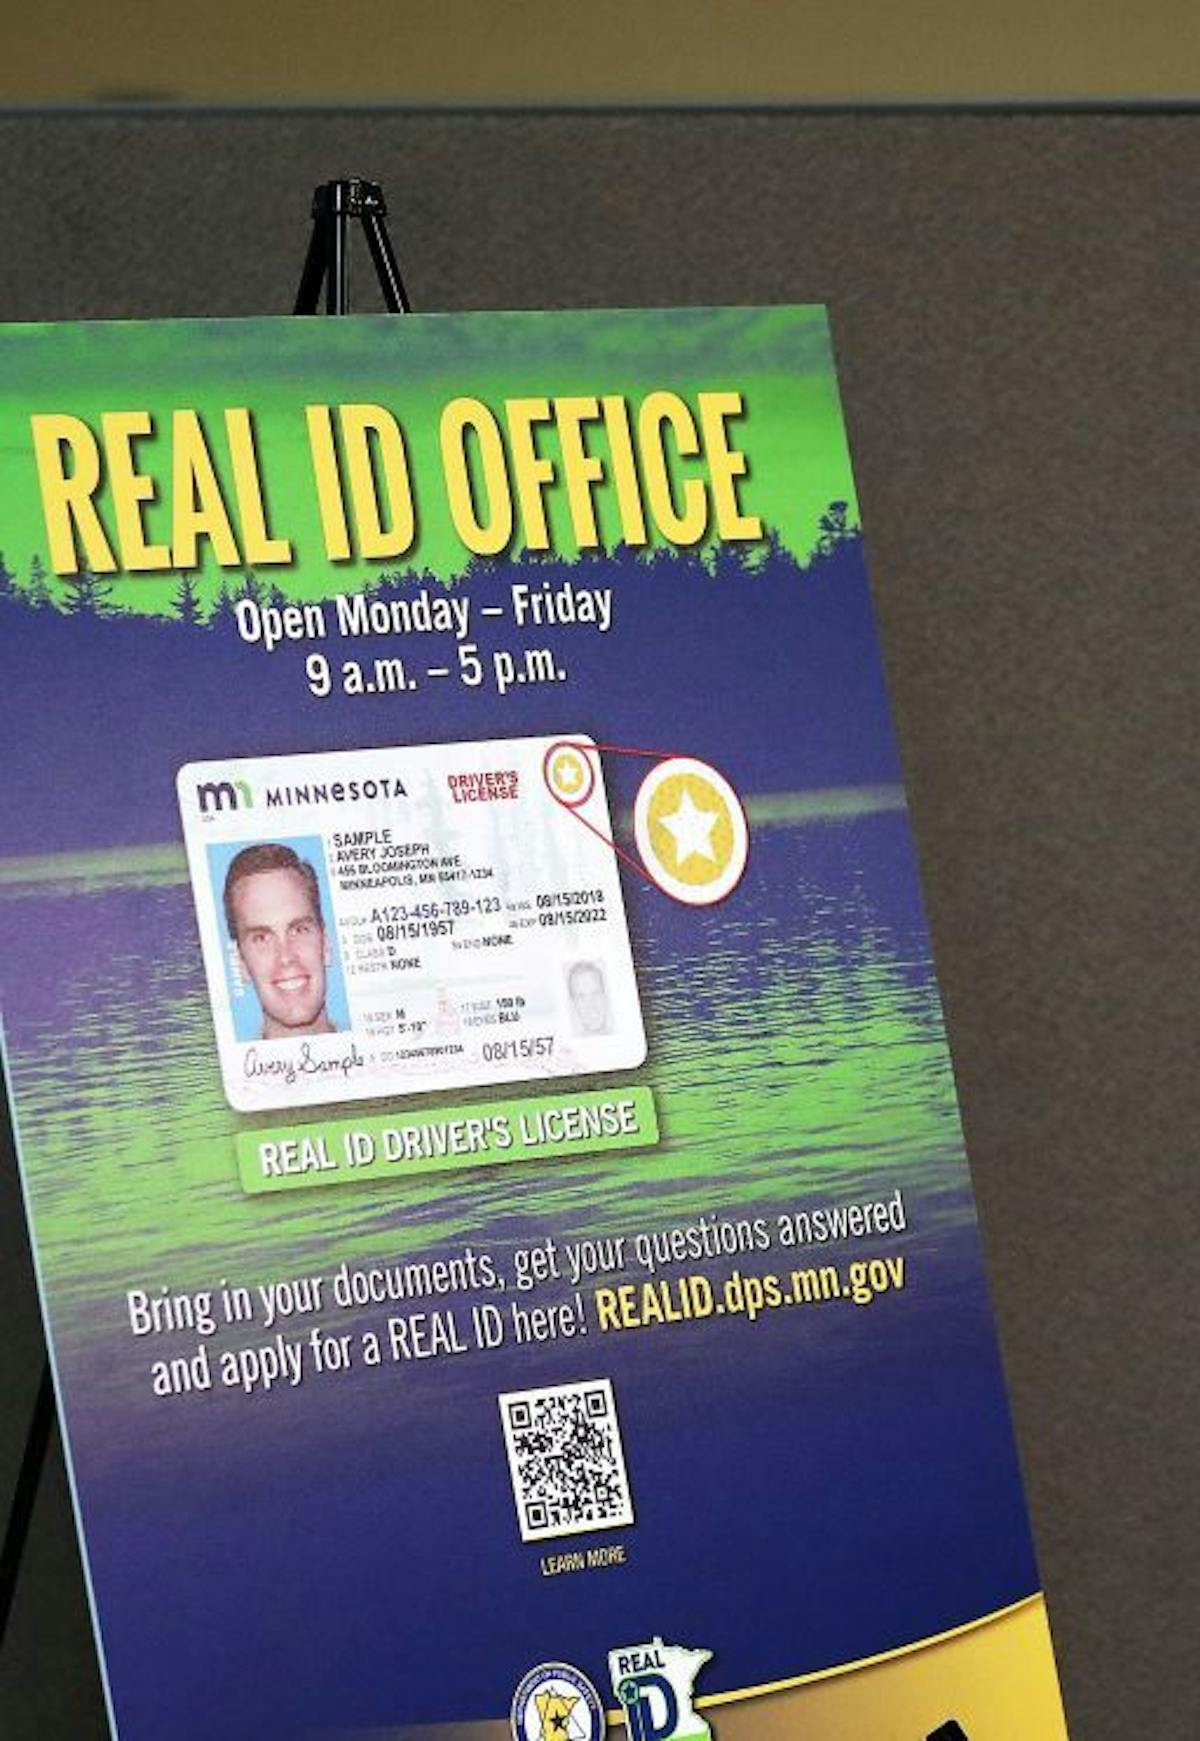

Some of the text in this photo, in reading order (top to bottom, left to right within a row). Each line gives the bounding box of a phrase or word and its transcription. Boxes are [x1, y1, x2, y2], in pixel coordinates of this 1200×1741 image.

[30, 390, 763, 575] REAL ID OFFICE
[236, 599, 326, 649] Open
[337, 587, 471, 639] Monday
[511, 581, 613, 632] Friday
[305, 653, 331, 697] 9
[341, 660, 417, 692] a.m.
[459, 645, 482, 687] 5
[495, 649, 567, 695] p.m.
[448, 770, 519, 790] DRIVER'S
[451, 784, 520, 804] LICENSE
[333, 829, 392, 848] SAMPLE
[337, 843, 430, 863] AVERY JOSEPH
[370, 897, 501, 923] A123-456-789-123
[377, 920, 455, 942] 08/15/1957
[482, 1036, 556, 1062] 08/15/57
[259, 1100, 641, 1179] REAL ID DRIVER'S LICENSE
[127, 1188, 907, 1336] Bring in your documents, get your questions answered
[151, 1256, 905, 1396] and apply for a REAL ID here! REALID.dps.mn.gov
[541, 1546, 627, 1577] LEARN MORE
[618, 1650, 666, 1676] REAL
